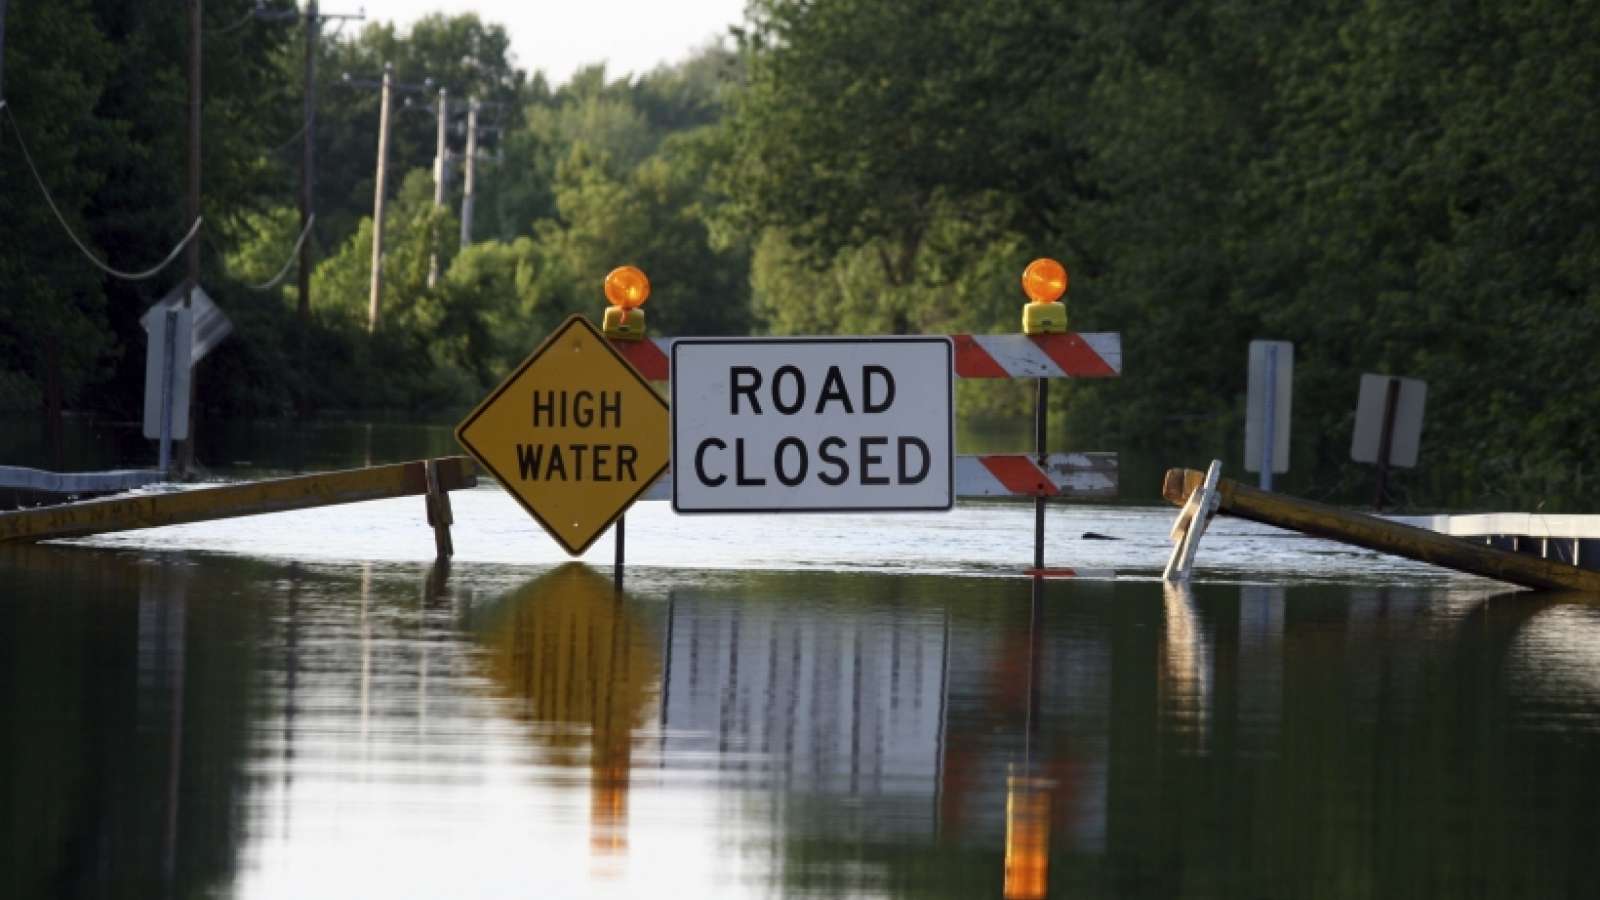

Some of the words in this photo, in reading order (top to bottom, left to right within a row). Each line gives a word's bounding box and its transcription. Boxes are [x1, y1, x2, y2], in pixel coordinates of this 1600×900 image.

[532, 390, 622, 428] HIGH
[729, 365, 897, 415] ROAD
[516, 443, 638, 482] WATER
[694, 436, 932, 487] CLOSED
